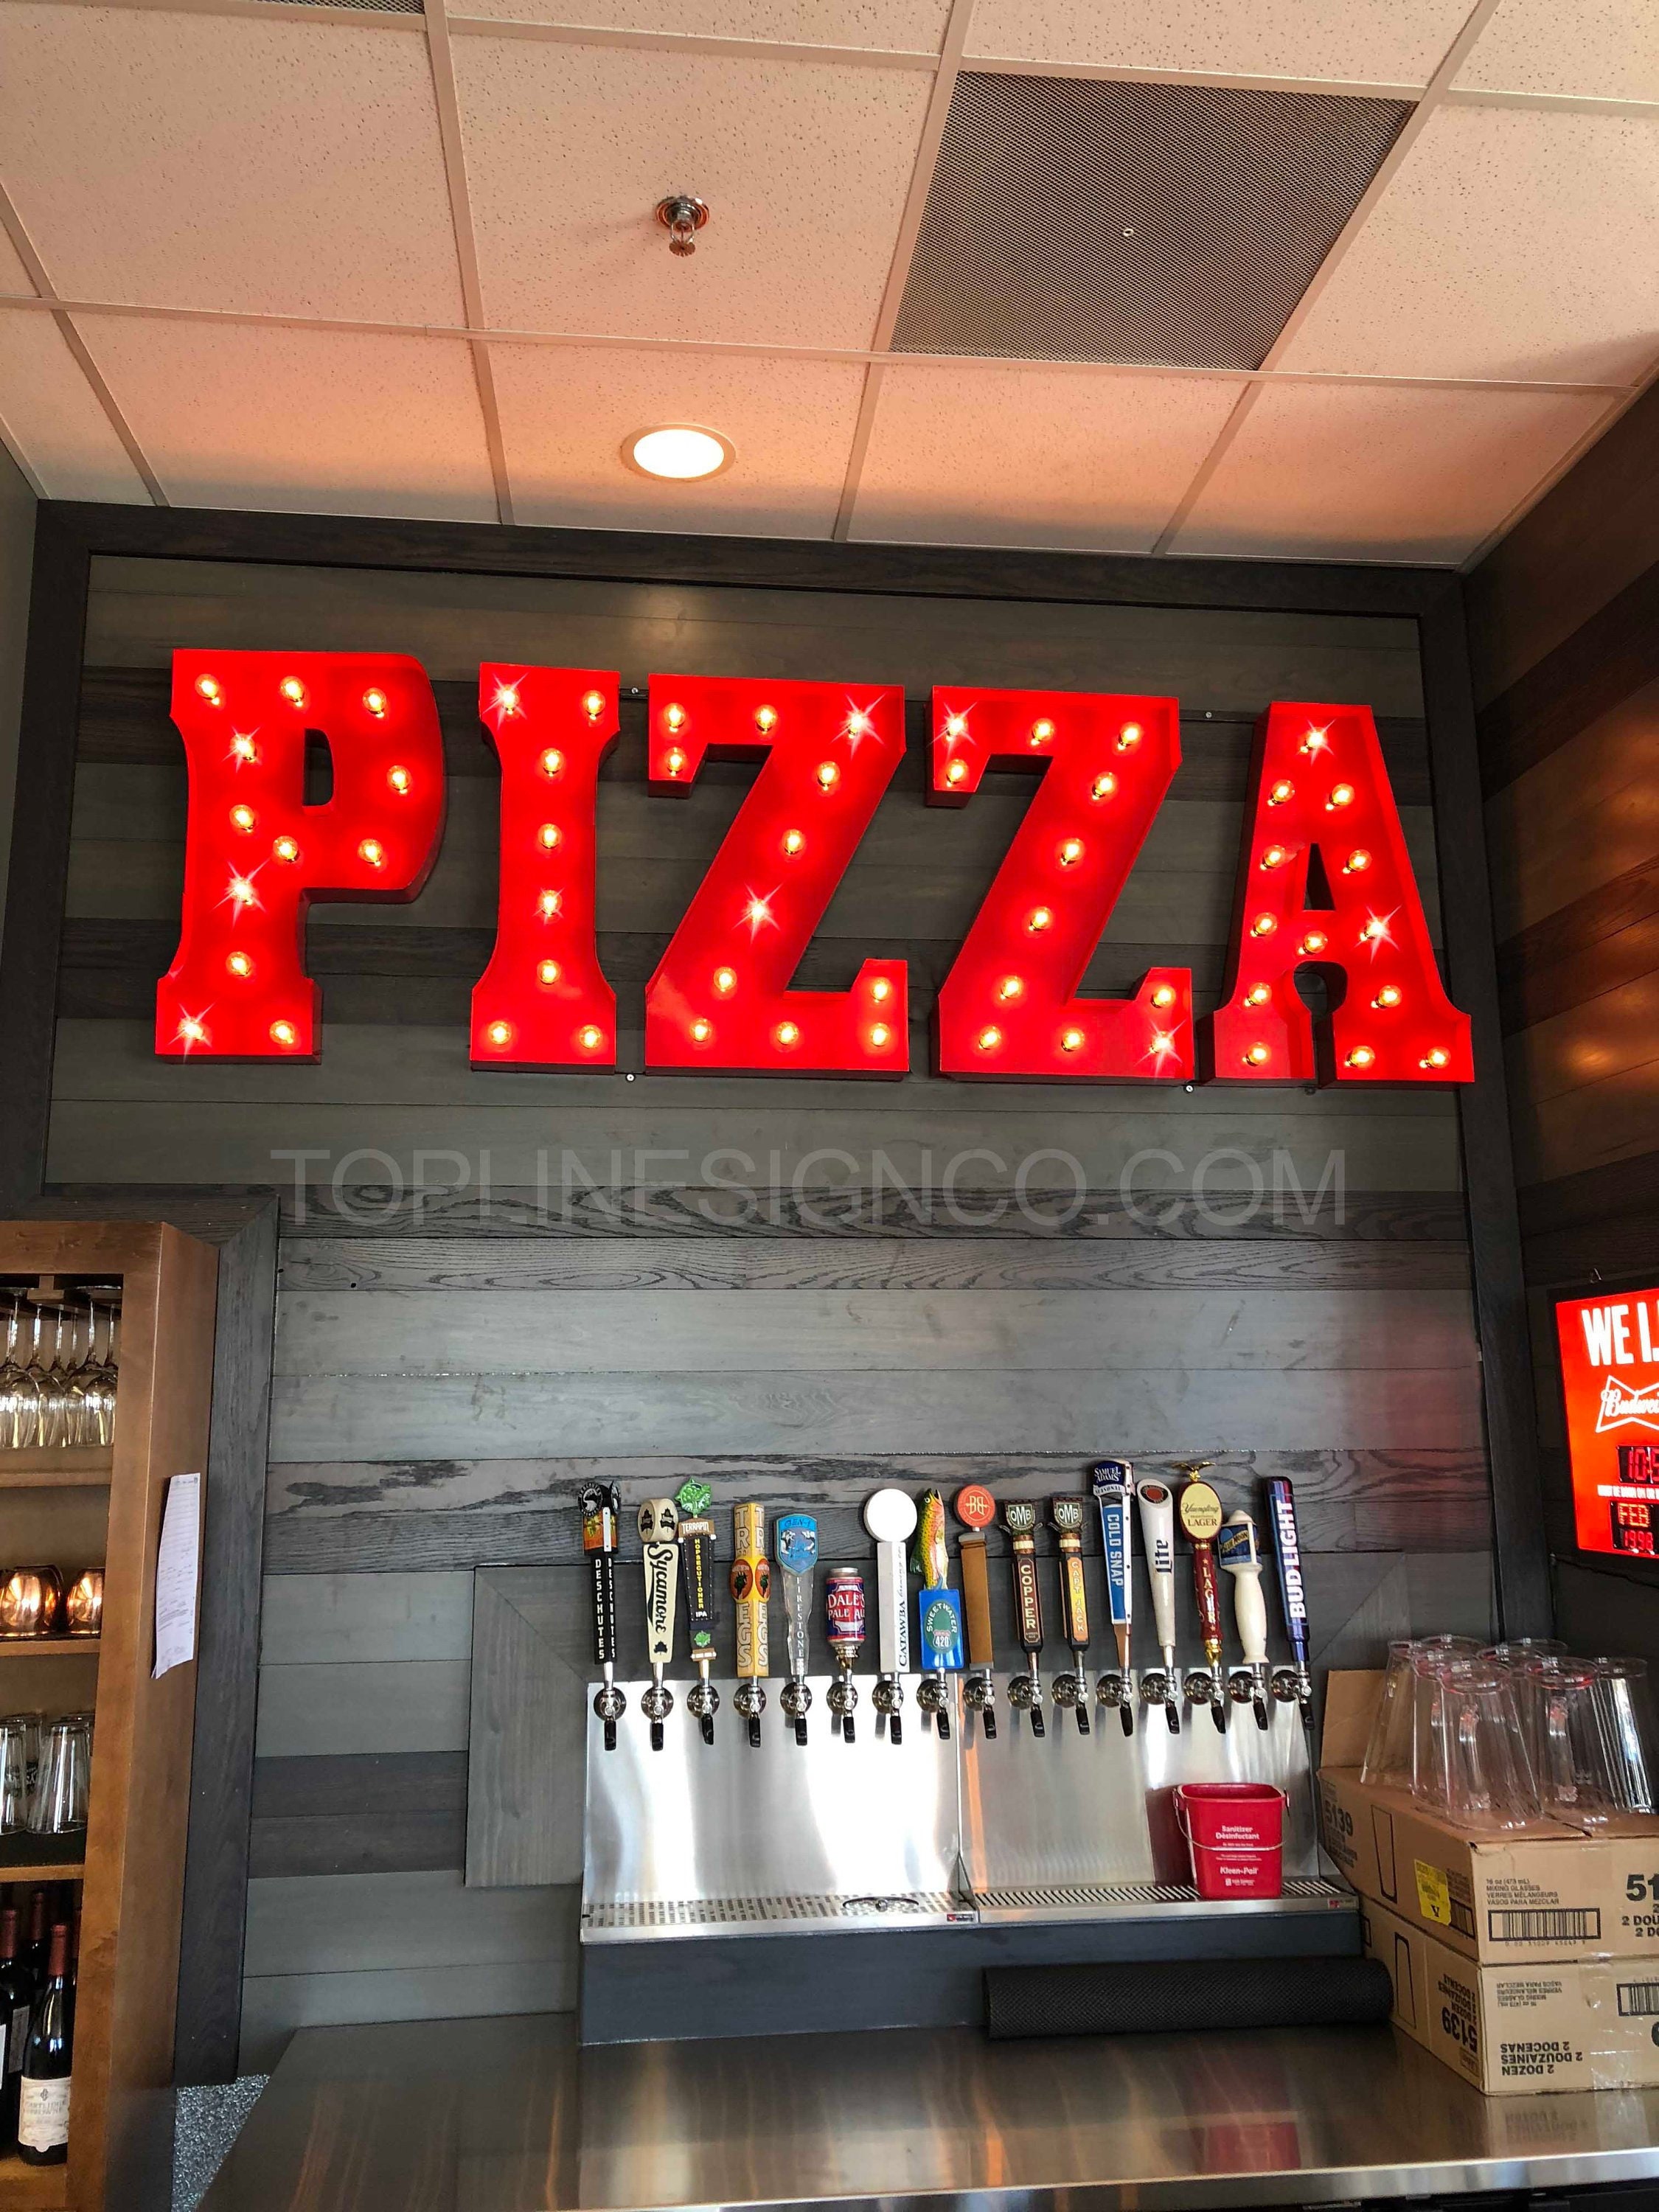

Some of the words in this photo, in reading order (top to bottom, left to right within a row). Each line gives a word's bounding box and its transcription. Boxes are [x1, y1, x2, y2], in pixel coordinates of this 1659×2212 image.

[155, 649, 1475, 1085] PIZZA
[681, 1521, 710, 1534] TERRAPIN
[1010, 1506, 1032, 1526] OMB
[1058, 1504, 1079, 1524] OMB
[1187, 1518, 1218, 1527] LAGER
[1618, 1501, 1651, 1528] FEB
[1107, 1514, 1121, 1547] COLD
[1276, 1500, 1298, 1566] LIGHT
[1071, 1561, 1080, 1594] CAPT
[1109, 1551, 1124, 1587] SNAP
[646, 1542, 675, 1635] Sycamore
[827, 1593, 866, 1609] DALE'S
[1020, 1565, 1036, 1629] COPPER
[1284, 1572, 1307, 1619] BUD
[594, 1559, 605, 1660] DESCHUTES
[608, 1557, 616, 1658] DESCHUTES
[796, 1576, 804, 1658] FIRESTONE
[828, 1608, 851, 1621] PALE
[926, 1602, 958, 1633] SWEETWATER
[1075, 1599, 1085, 1632] JACK
[898, 1599, 908, 1667] CATAWBA
[935, 1635, 950, 1647] 420
[1622, 1916, 1630, 1926] 2
[1635, 1927, 1644, 1938] 2
[1441, 2006, 1478, 2053] 5139
[1500, 2042, 1559, 2053] DOCENAS
[1500, 2052, 1572, 2065] DOUZAINES
[1562, 2042, 1570, 2051] 2
[1575, 2052, 1583, 2062] 2
[1502, 2065, 1544, 2076] DOZEN
[1547, 2065, 1554, 2074] 2
